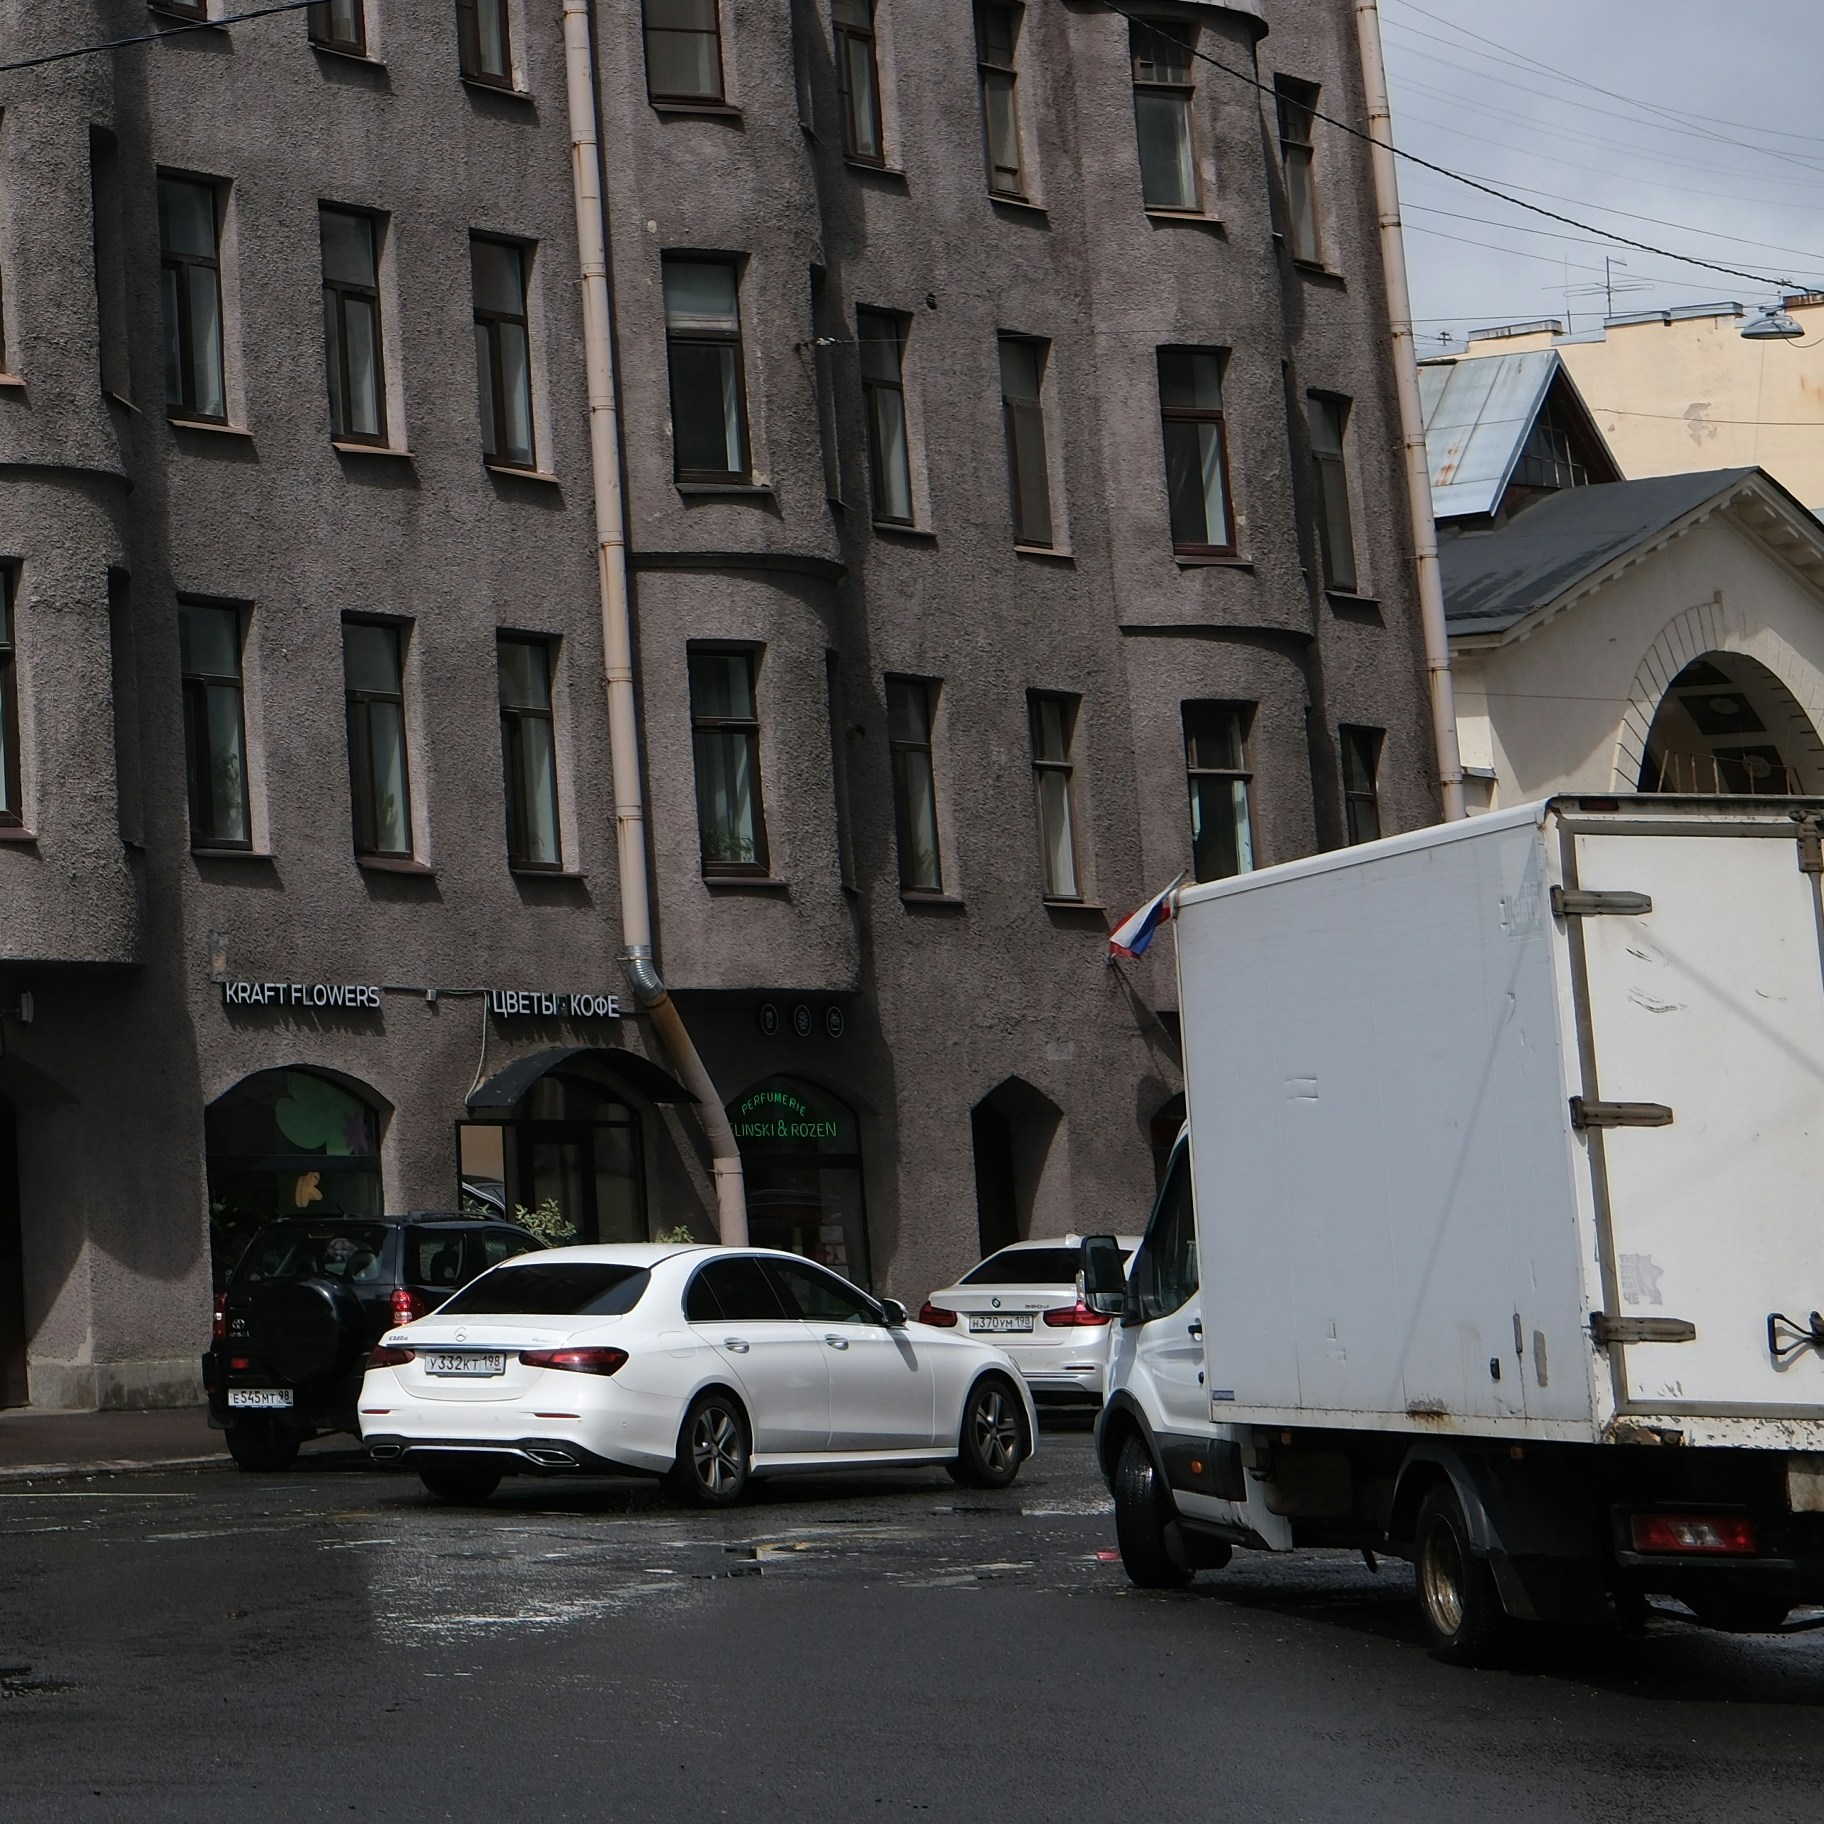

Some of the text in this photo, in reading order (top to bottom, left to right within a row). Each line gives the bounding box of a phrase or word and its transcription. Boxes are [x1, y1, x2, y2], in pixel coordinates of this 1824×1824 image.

[226, 982, 380, 1007] KRAFT FLOWERS
[493, 990, 620, 1018] ЦВЕТЫ КОФЕ
[741, 1092, 806, 1117] PERFUMERIE
[778, 1120, 788, 1136] &
[792, 1122, 837, 1137] ROZEN
[430, 1355, 500, 1371] У332КТ 198
[233, 1390, 290, 1404] Е545МТ 98
